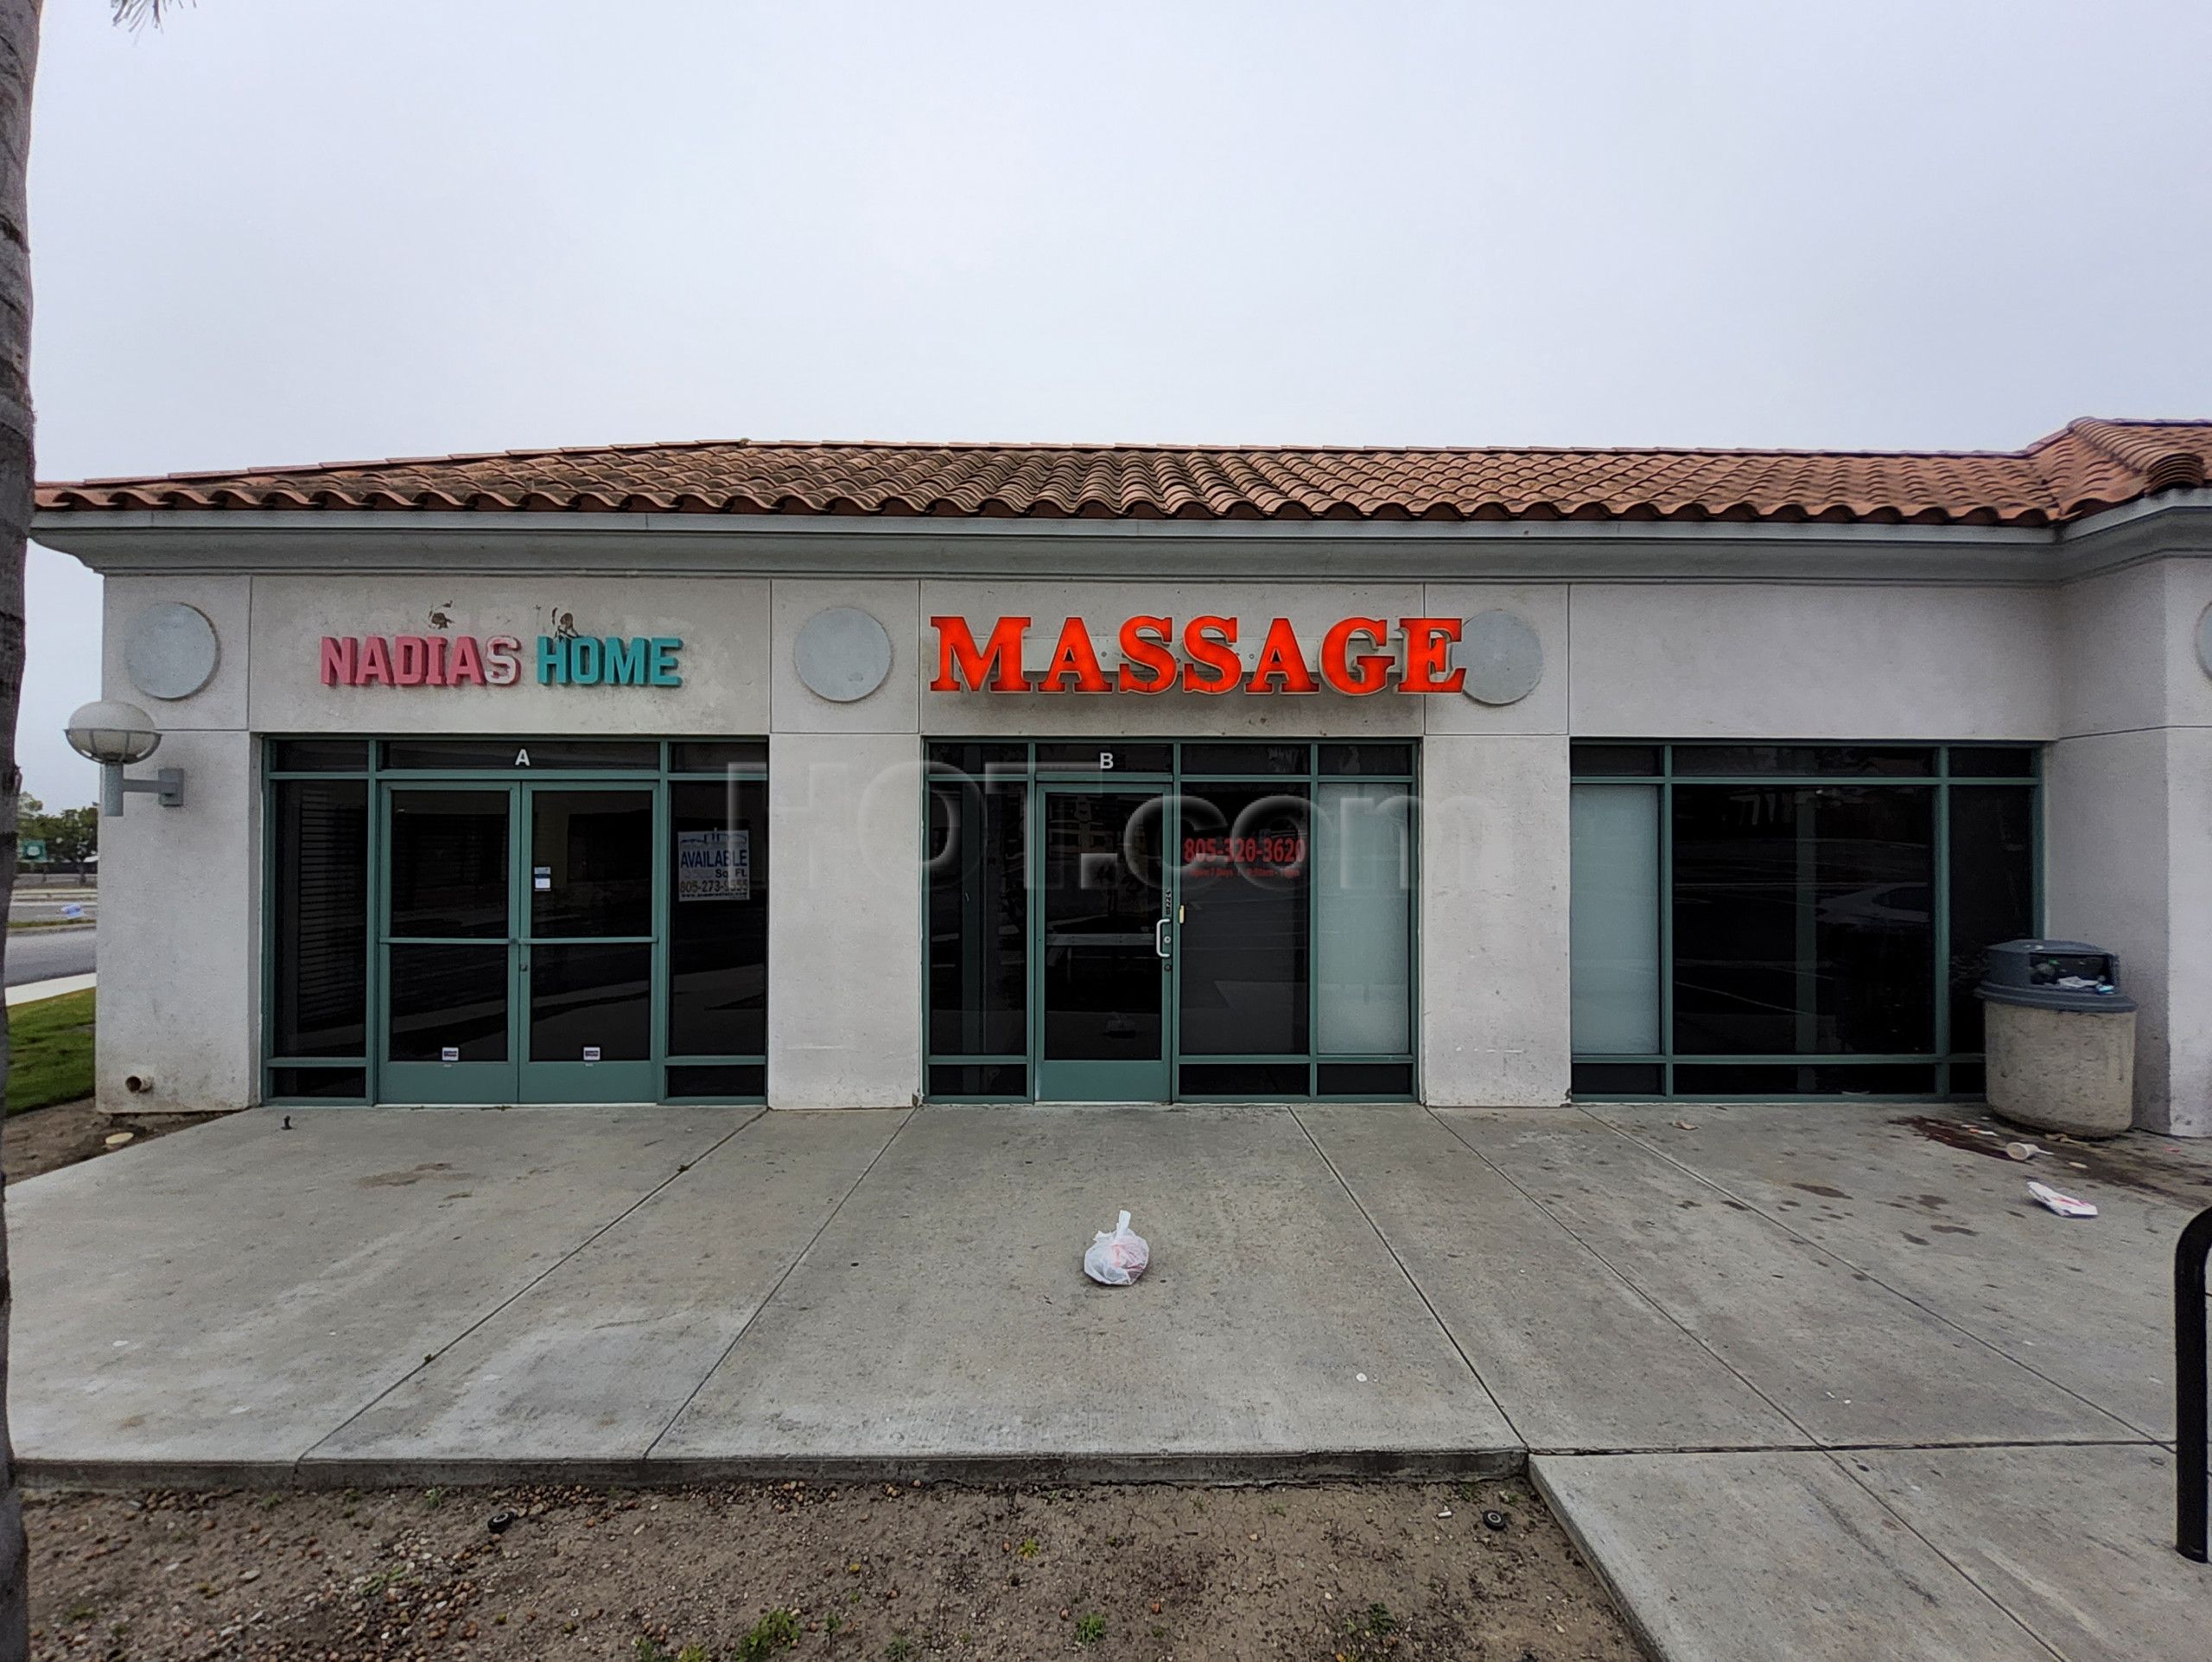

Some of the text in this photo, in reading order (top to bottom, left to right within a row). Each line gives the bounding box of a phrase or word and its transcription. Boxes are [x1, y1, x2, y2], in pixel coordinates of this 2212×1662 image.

[321, 634, 683, 688] NADIAS HOME
[930, 614, 1467, 696] MASSAGE
[515, 748, 531, 767] A
[1100, 752, 1114, 769] B
[680, 850, 747, 868] AVAILABLE
[1184, 837, 1306, 863] 805-320-3620
